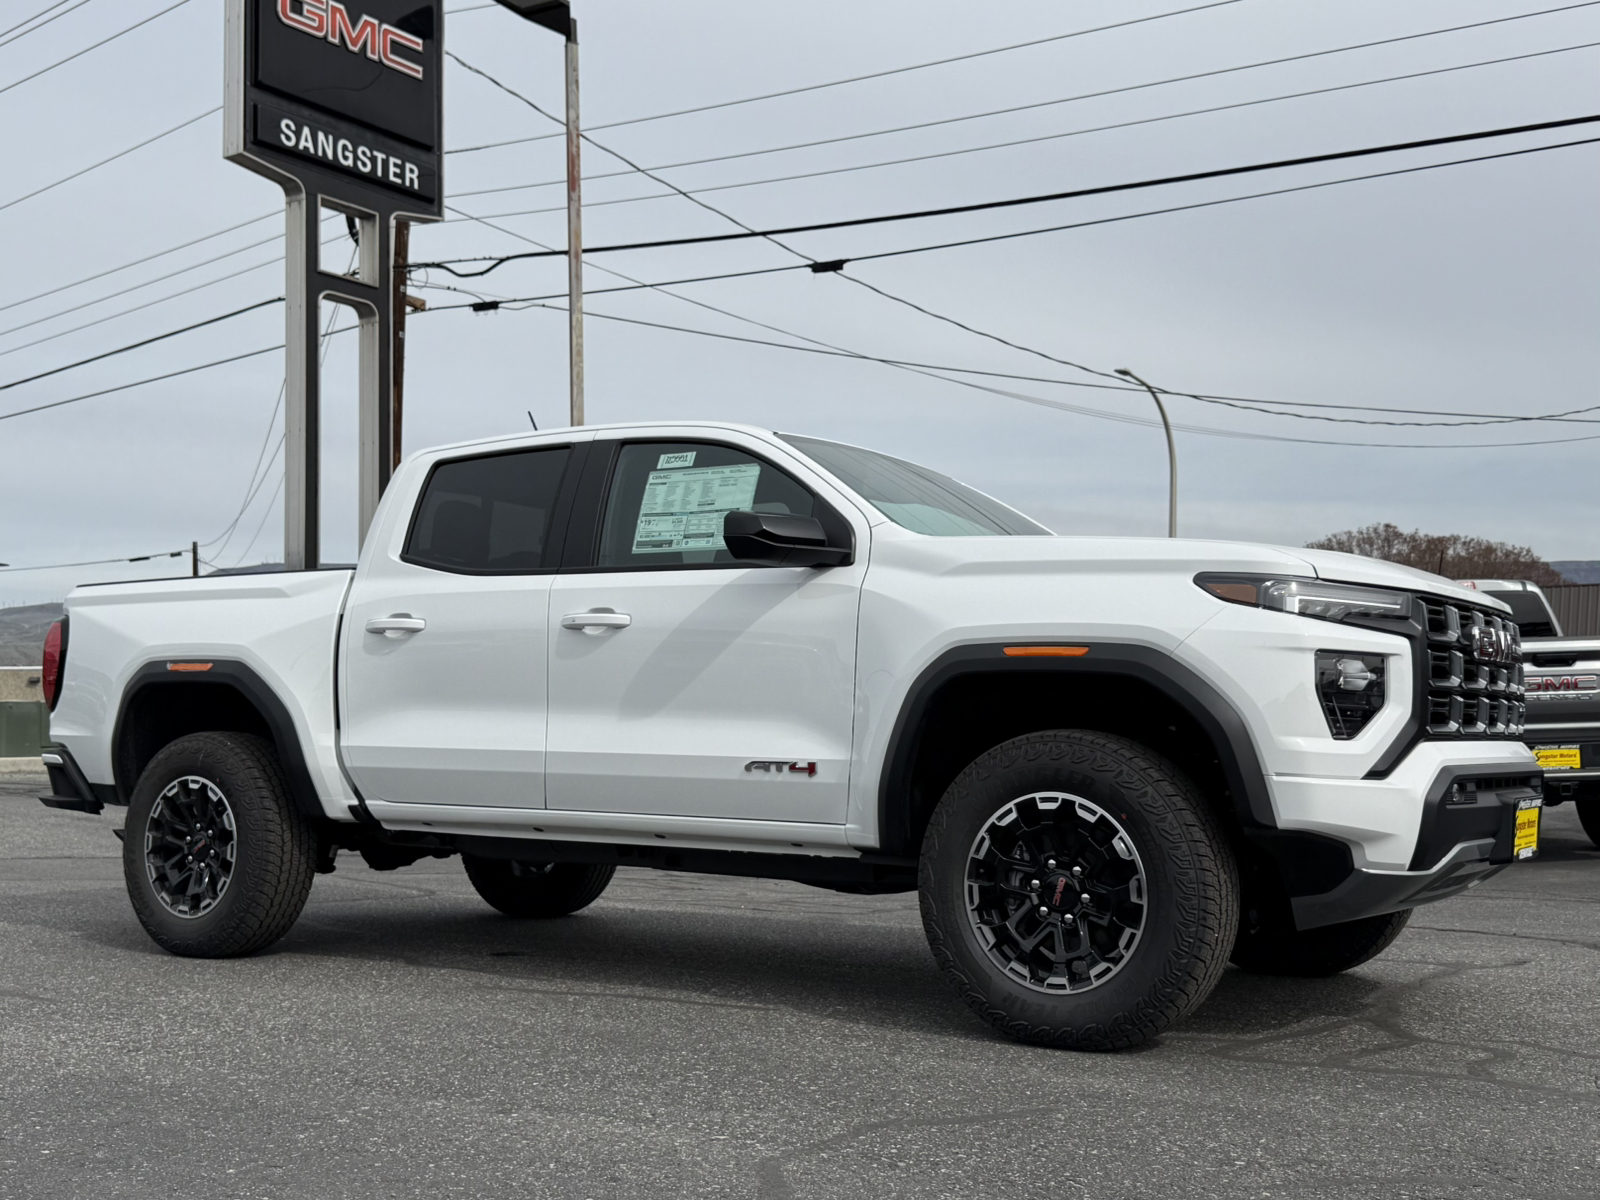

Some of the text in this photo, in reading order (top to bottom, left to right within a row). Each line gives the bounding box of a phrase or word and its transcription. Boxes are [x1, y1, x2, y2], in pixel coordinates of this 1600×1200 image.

[277, 0, 423, 81] GMC
[280, 118, 419, 190] SANGSTER
[1524, 675, 1597, 692] GMC
[744, 760, 818, 778] AT4
[1052, 877, 1067, 906] GMC
